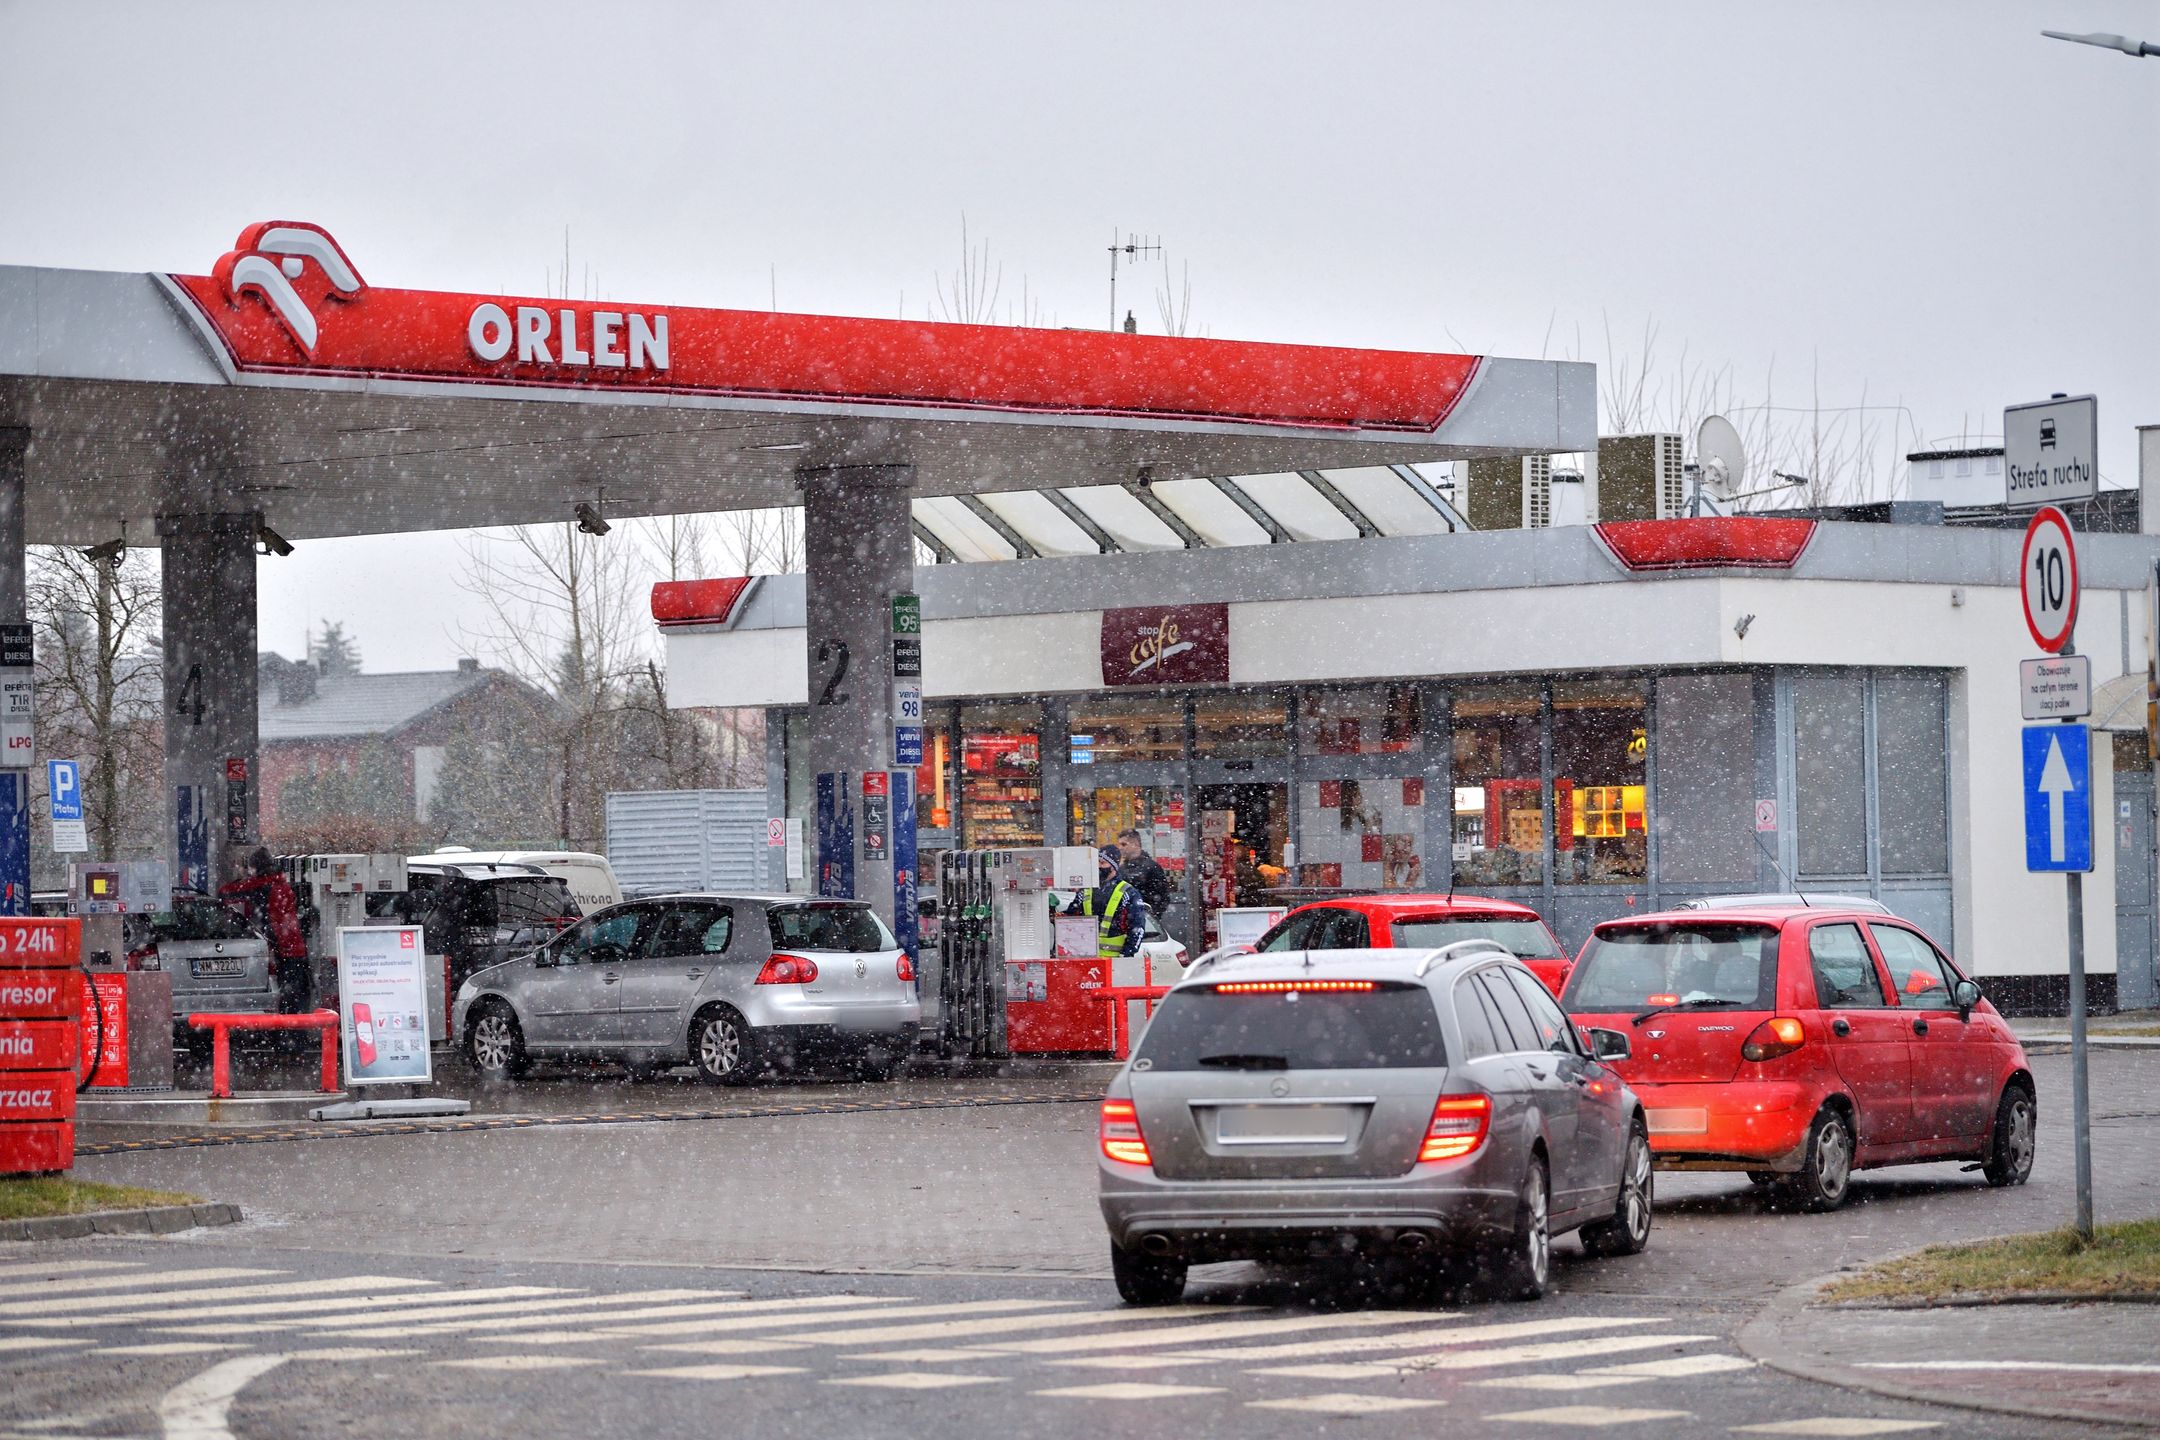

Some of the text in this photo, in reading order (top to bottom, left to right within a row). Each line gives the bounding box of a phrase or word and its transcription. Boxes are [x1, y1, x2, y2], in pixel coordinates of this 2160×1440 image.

[468, 303, 670, 370] ORLEN
[2010, 456, 2090, 490] Strefa ruchu
[2036, 548, 2064, 611] 10
[900, 615, 917, 631] 95
[1137, 625, 1159, 636] stop
[1130, 615, 1179, 670] cafe
[4, 652, 31, 660] DIESEL
[818, 639, 850, 705] 2
[897, 663, 920, 671] DIESEL
[176, 663, 206, 725] 4
[2058, 682, 2078, 692] terenie
[10, 694, 29, 706] TIR
[902, 701, 918, 716] 98
[9, 737, 32, 748] LPG
[900, 748, 920, 756] DIESEL
[55, 764, 74, 800] P
[53, 803, 80, 817] Płatny
[574, 891, 613, 905] hrona
[15, 926, 55, 952] 24h
[0, 1030, 33, 1055] nia
